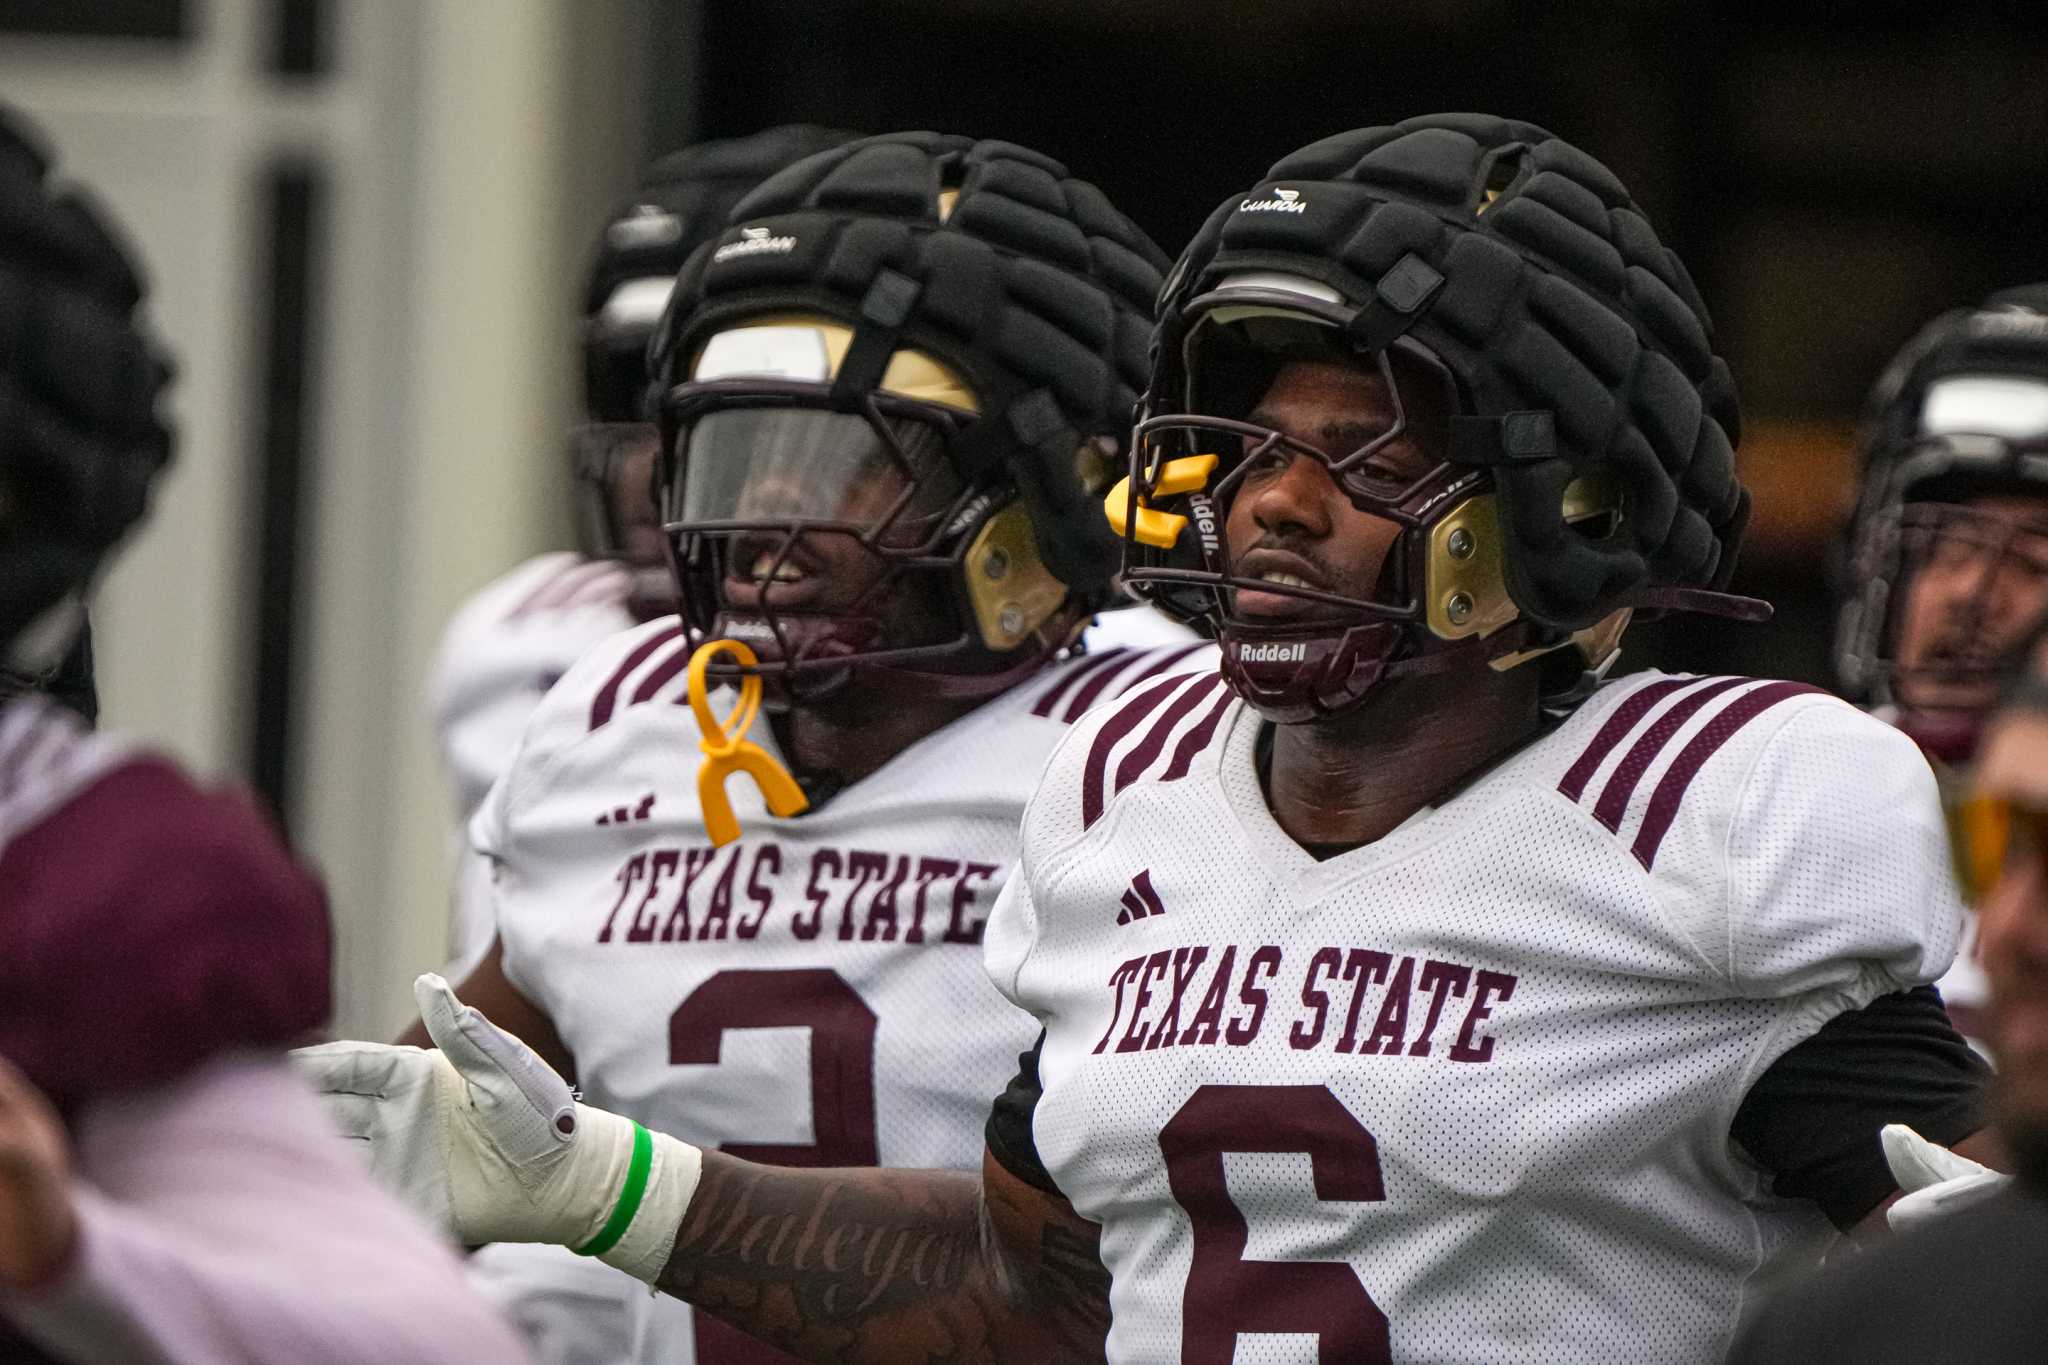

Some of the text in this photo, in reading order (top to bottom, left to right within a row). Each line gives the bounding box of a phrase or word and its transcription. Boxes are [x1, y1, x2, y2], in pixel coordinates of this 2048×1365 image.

[1188, 493, 1219, 551] ddell
[1240, 643, 1306, 662] Riddell
[597, 843, 1000, 945] TEXAS STATE
[1091, 944, 1519, 1063] TEXAS STATE
[1157, 1084, 1393, 1365] 6
